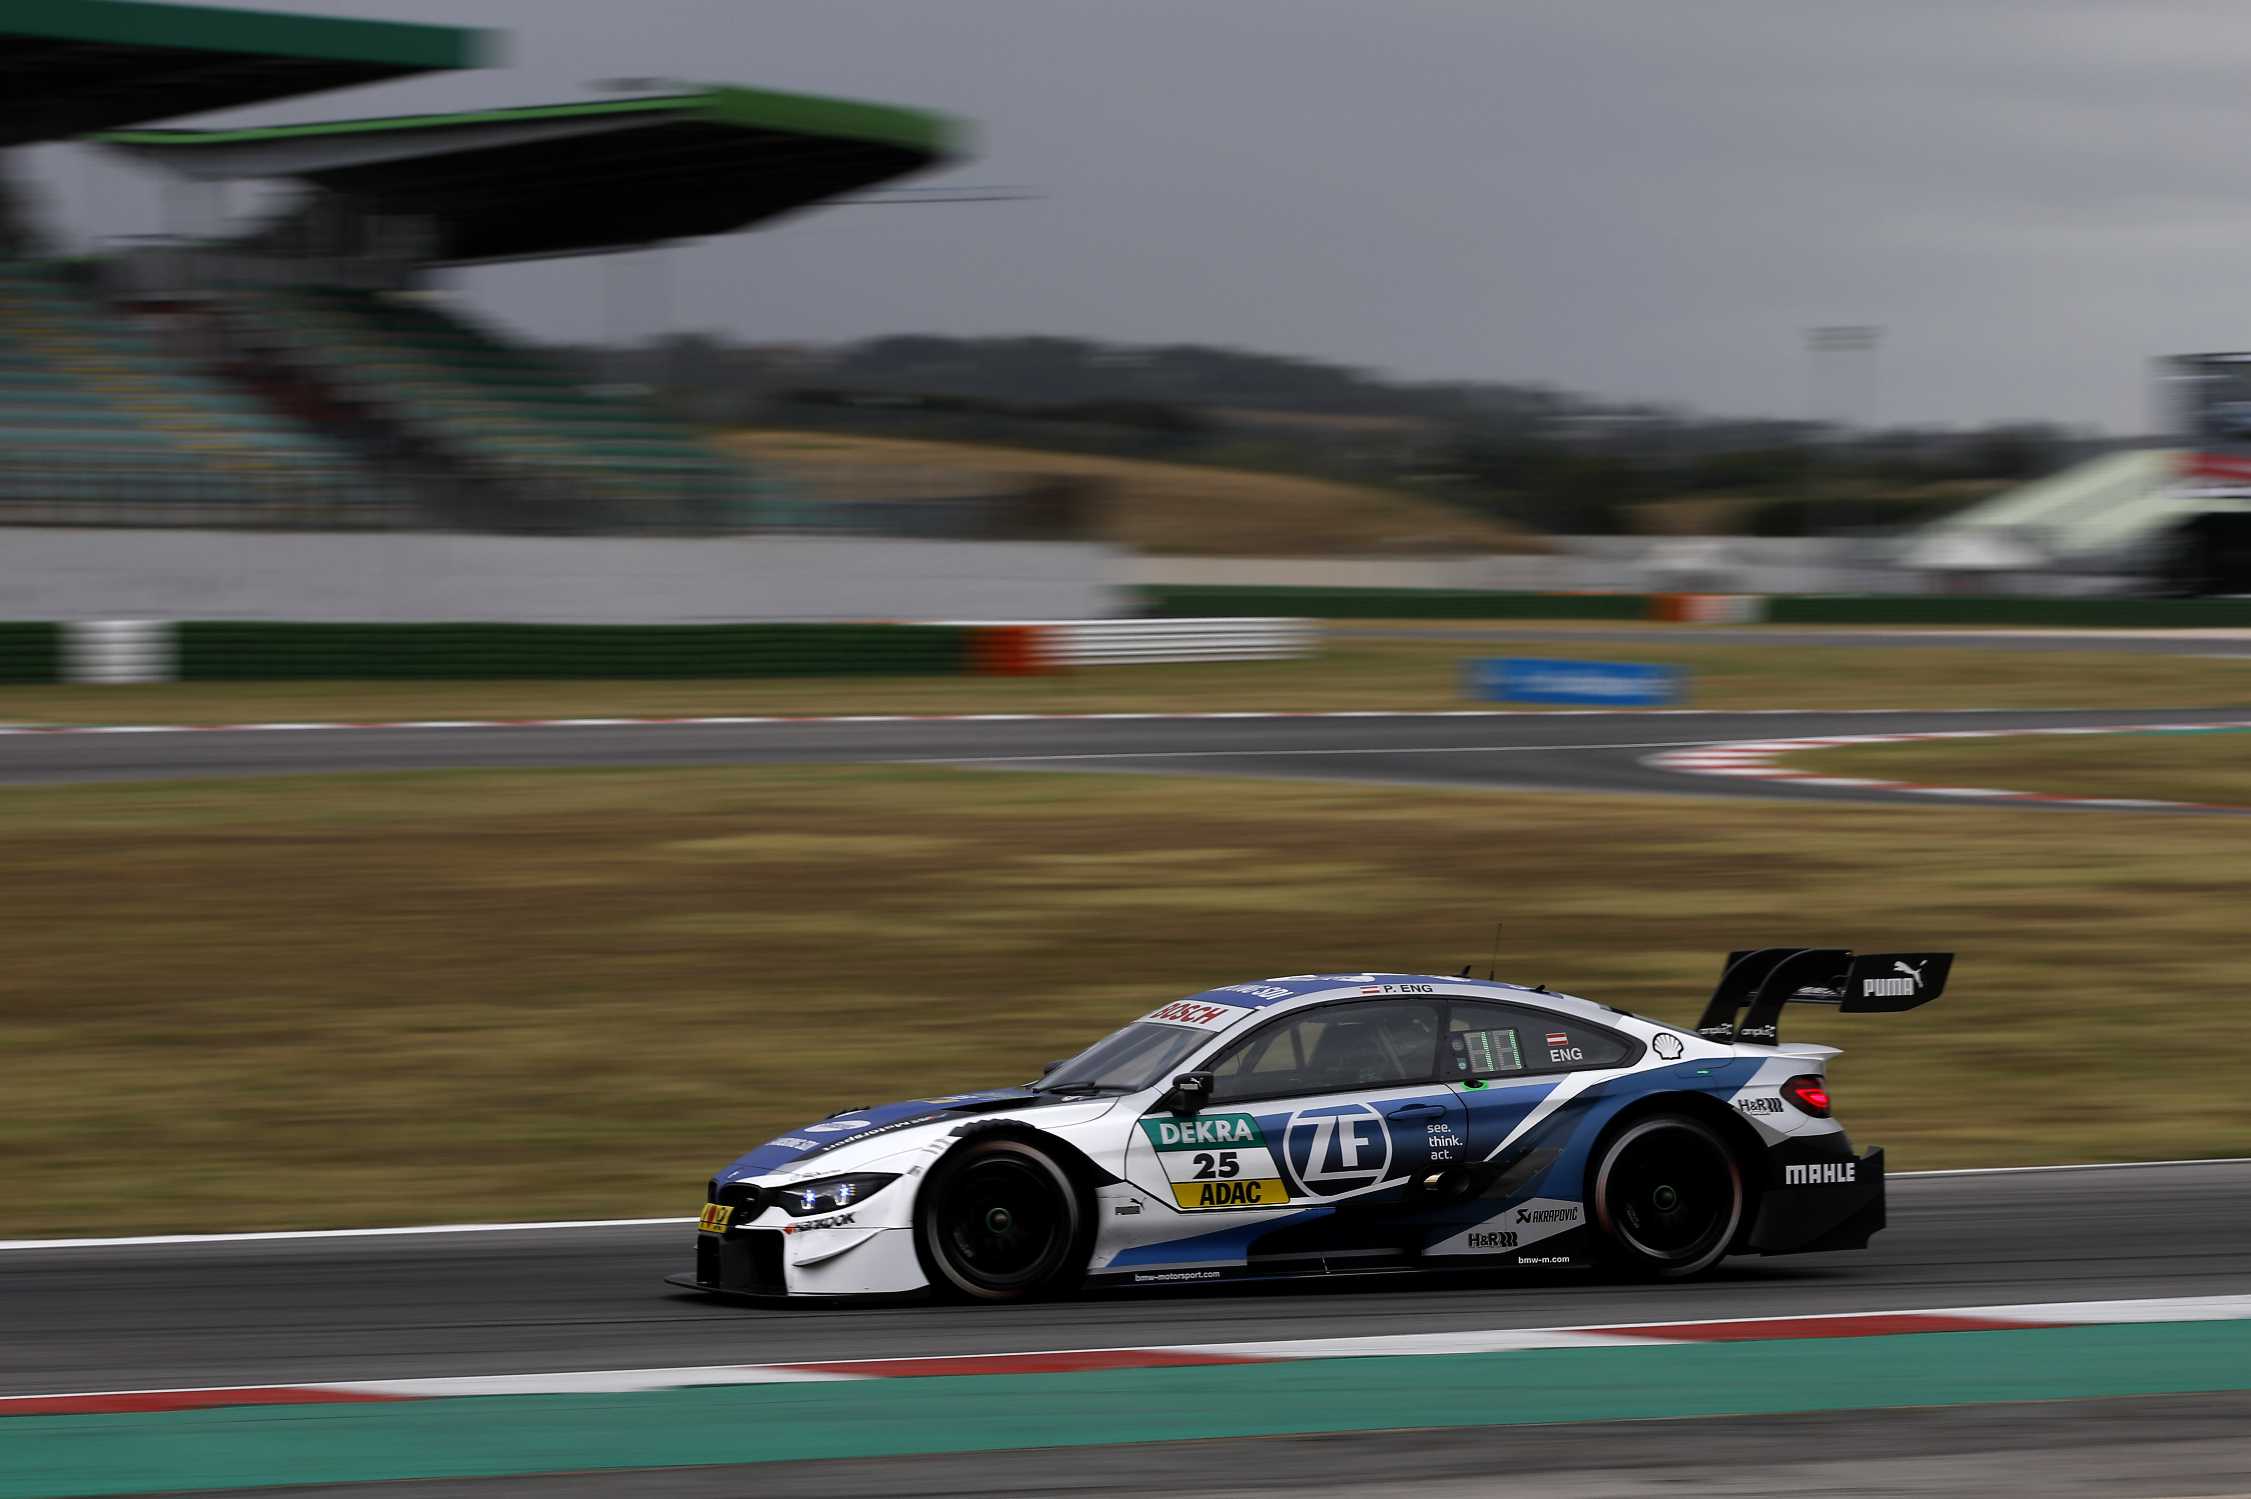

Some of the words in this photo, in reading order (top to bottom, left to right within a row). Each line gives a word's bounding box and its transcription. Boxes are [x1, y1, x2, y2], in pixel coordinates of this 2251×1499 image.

[1384, 984, 1396, 993] P.
[1402, 984, 1433, 993] ENG
[1863, 978, 1914, 997] PUMA
[1151, 1002, 1228, 1025] BOSCH
[1550, 1047, 1584, 1063] ENG
[1738, 1098, 1767, 1111] H&R
[1159, 1118, 1255, 1145] DEKRA
[1427, 1123, 1451, 1133] see.
[1288, 1110, 1386, 1183] ZF
[1428, 1135, 1463, 1147] think.
[1431, 1149, 1453, 1160] act.
[1192, 1152, 1240, 1180] 25
[1785, 1162, 1856, 1185] MAHLE
[1199, 1180, 1262, 1206] ADAC
[1468, 1232, 1499, 1247] H&R
[1518, 1256, 1570, 1264] bmw-m.com
[1134, 1271, 1221, 1281] bmw-motorsport.com
